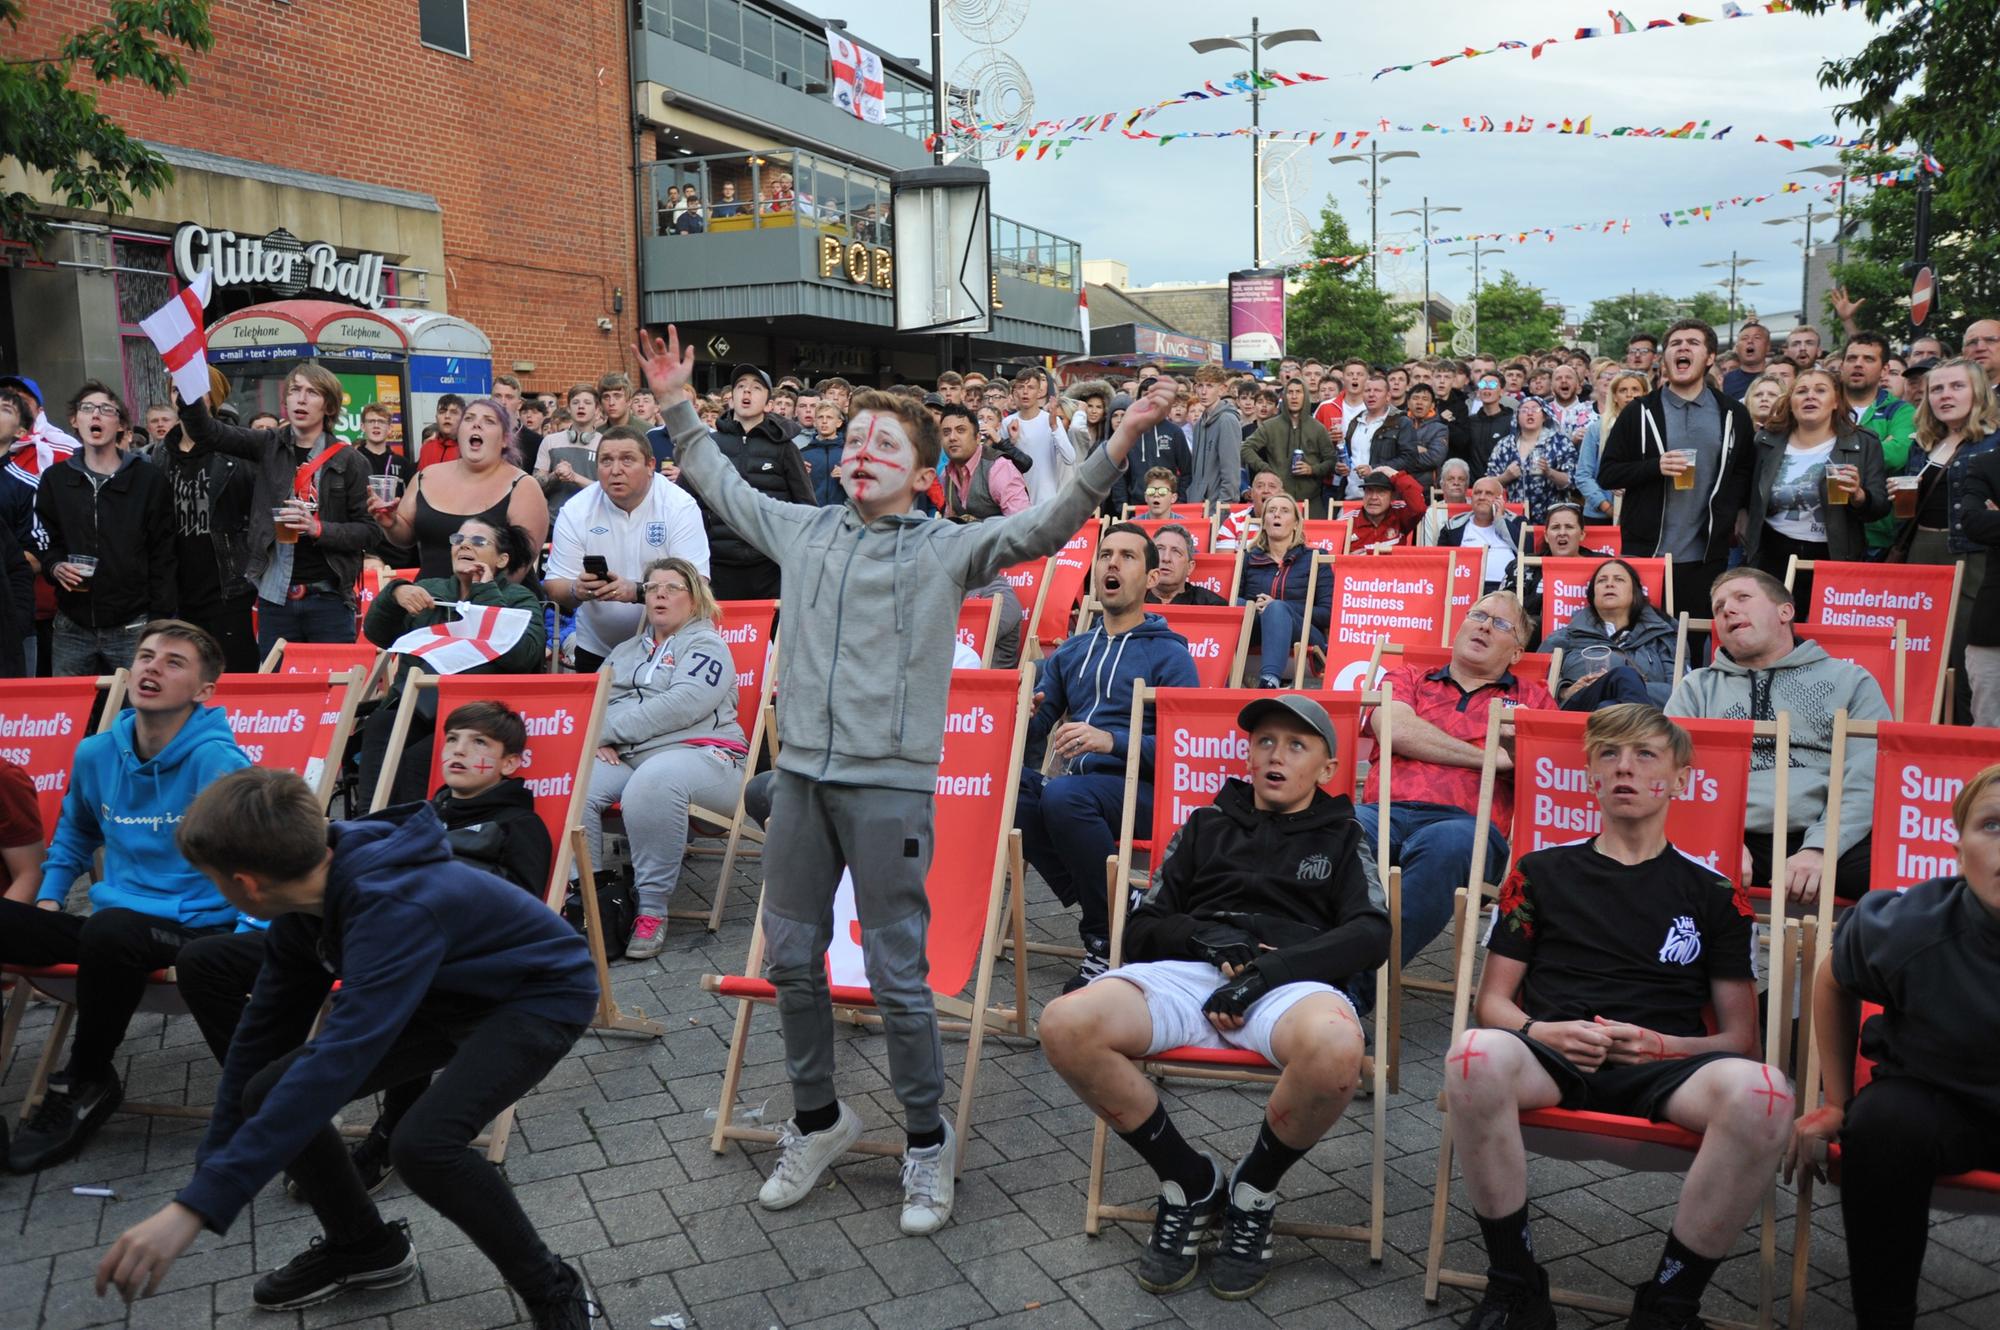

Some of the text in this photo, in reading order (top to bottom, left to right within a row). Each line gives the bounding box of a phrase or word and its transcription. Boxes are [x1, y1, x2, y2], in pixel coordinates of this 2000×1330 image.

[176, 224, 384, 309] Glitter Ball
[233, 325, 280, 341] Telephone
[341, 324, 381, 339] Telephone
[220, 348, 297, 359] e-mail text phone
[352, 349, 366, 358] text
[1344, 576, 1434, 595] Sunderland's
[1342, 593, 1404, 611] Business
[1824, 586, 1933, 610] Sunderland's
[1341, 609, 1433, 631] Improvement
[1822, 607, 1895, 628] Business
[718, 623, 757, 643] land's
[688, 652, 723, 687] 79
[226, 709, 305, 733] derland's
